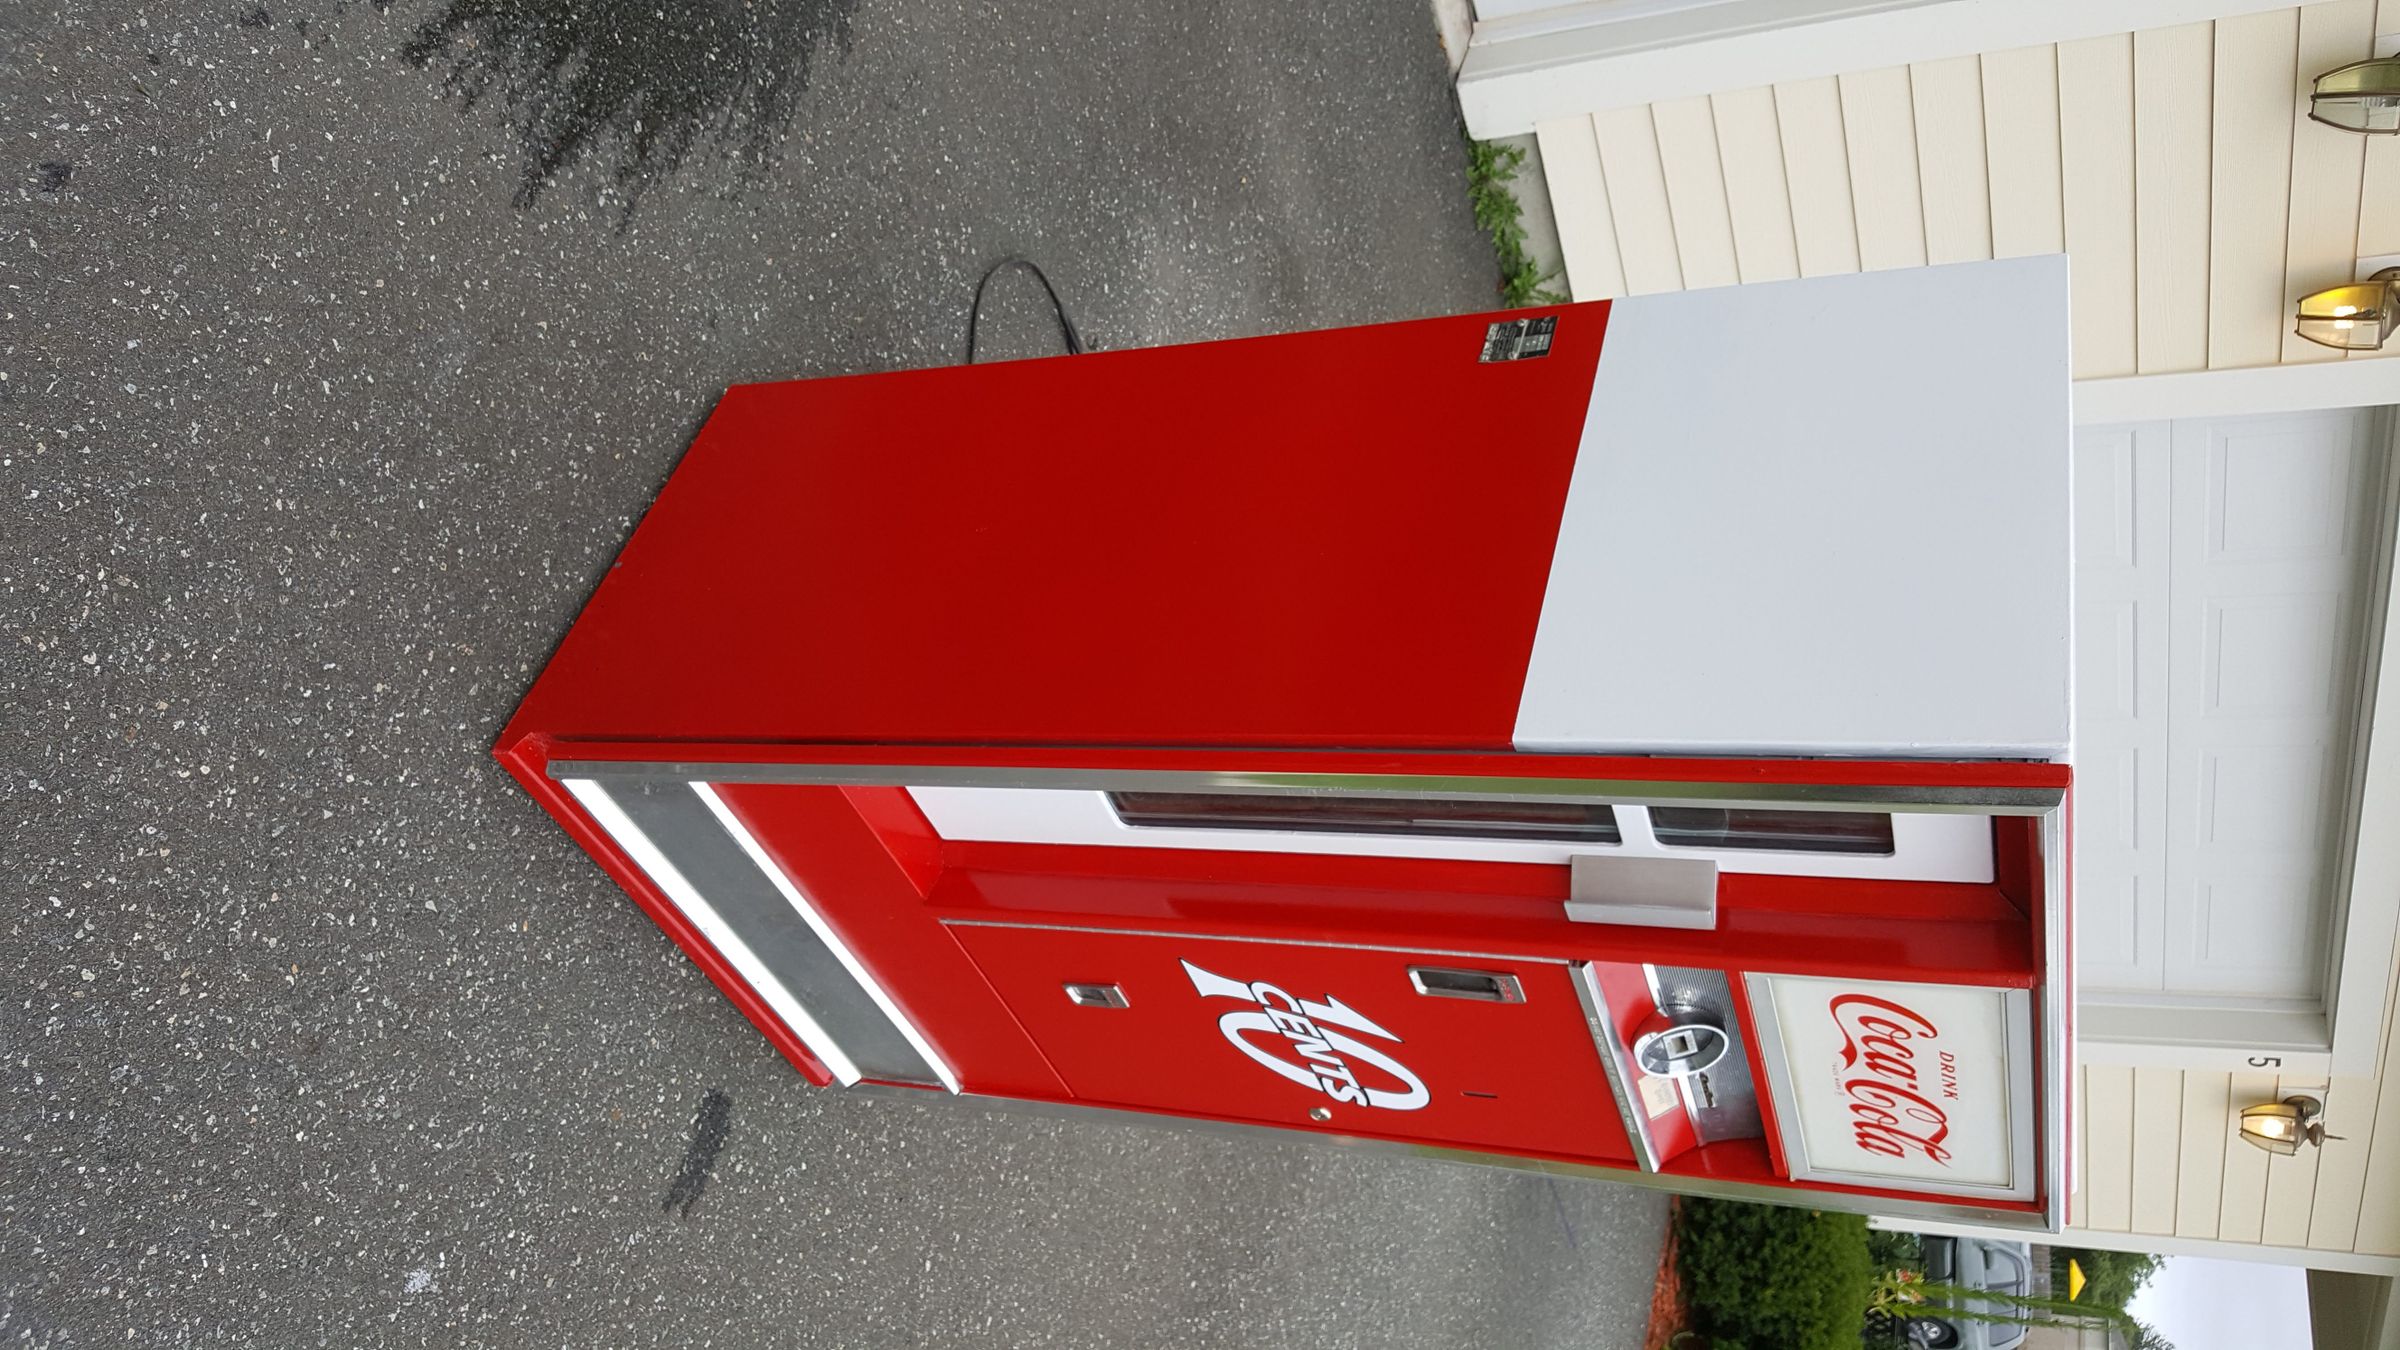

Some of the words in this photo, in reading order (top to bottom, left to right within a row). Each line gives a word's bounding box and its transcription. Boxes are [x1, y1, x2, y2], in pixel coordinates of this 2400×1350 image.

[1179, 957, 1431, 1111] 10
[1248, 981, 1368, 1107] CENTS
[1938, 1051, 1959, 1101] DRINK
[2248, 1056, 2281, 1068] 5
